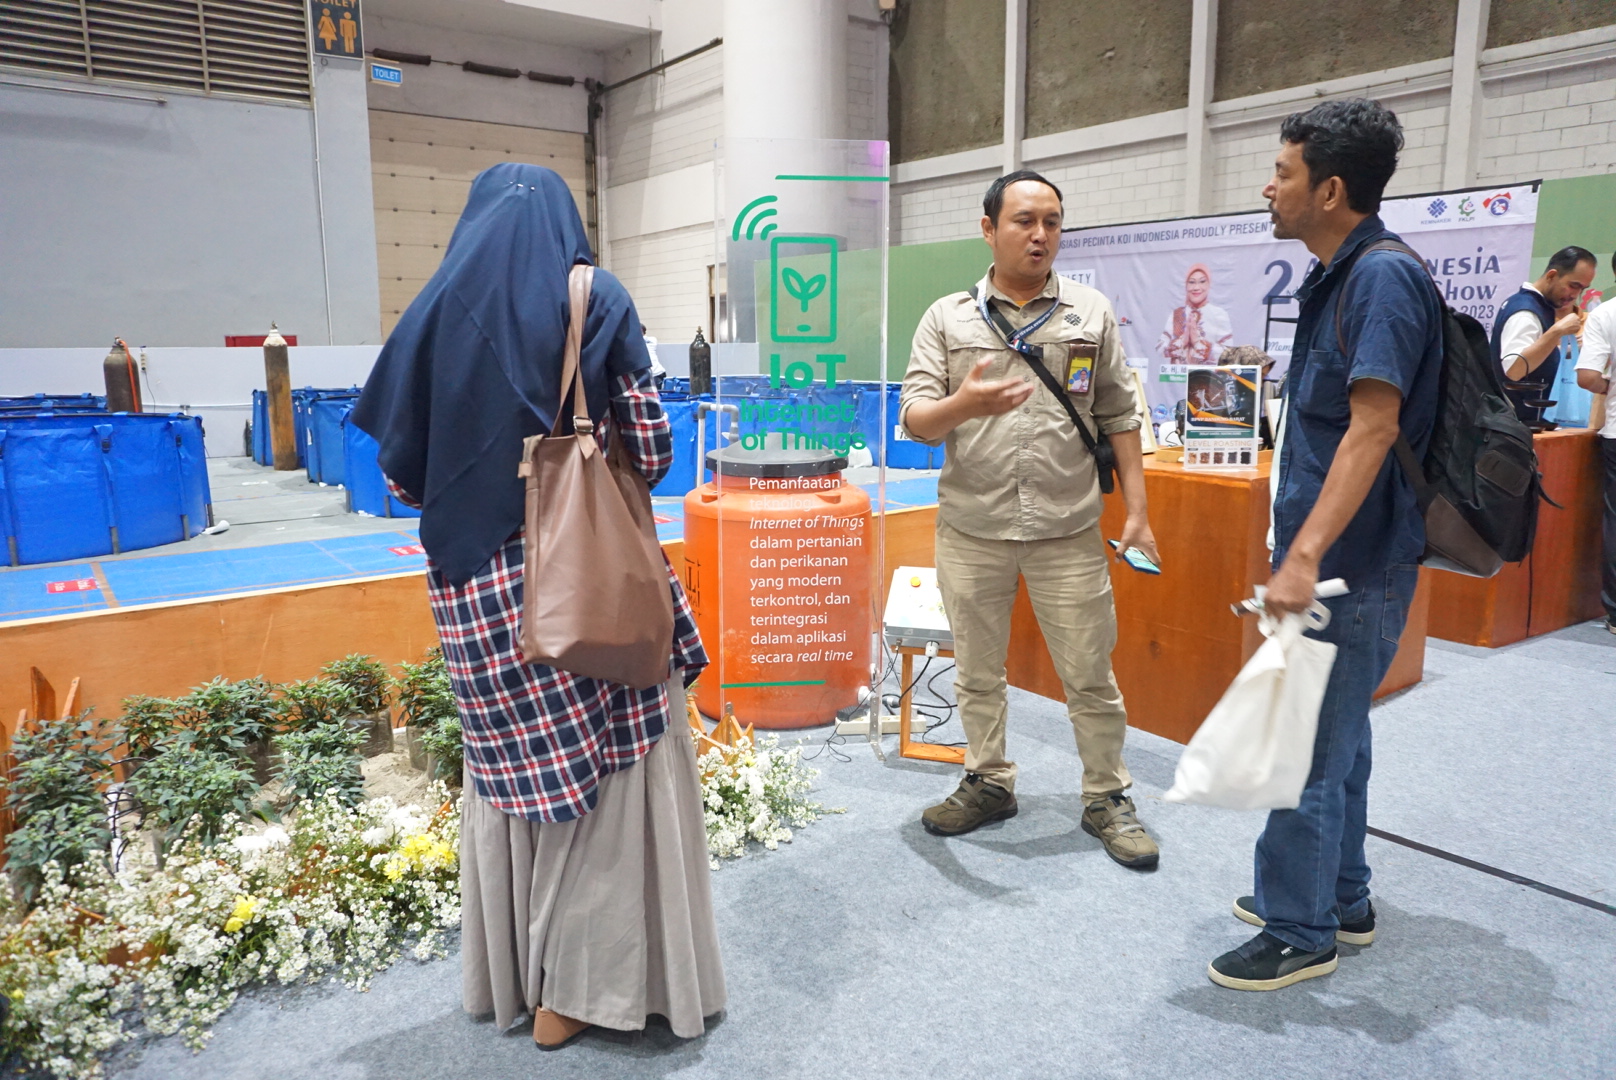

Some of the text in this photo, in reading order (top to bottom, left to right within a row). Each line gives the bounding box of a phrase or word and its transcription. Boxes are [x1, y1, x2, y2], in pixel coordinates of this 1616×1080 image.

[315, 0, 356, 8] OILET
[374, 68, 399, 80] TOILET
[1083, 235, 1115, 247] PECINTA
[1118, 234, 1131, 244] KOI
[1133, 229, 1180, 243] INDONESIA
[1182, 225, 1227, 239] PROUDLY
[1461, 304, 1495, 319] 2023
[770, 354, 846, 389] IoT
[741, 399, 856, 423] Internet
[741, 427, 867, 458] of Things
[750, 476, 841, 490] Pemanfaatan
[750, 515, 864, 530] Internet of Things
[750, 535, 862, 550] dalam pertanian
[750, 555, 848, 570] dan perikanan
[750, 574, 841, 591] yang modern
[750, 592, 850, 607] terkontrol, dan
[750, 612, 828, 627] terintegrasi
[751, 630, 846, 646] dalam aplikasi
[751, 649, 853, 664] secara real time
